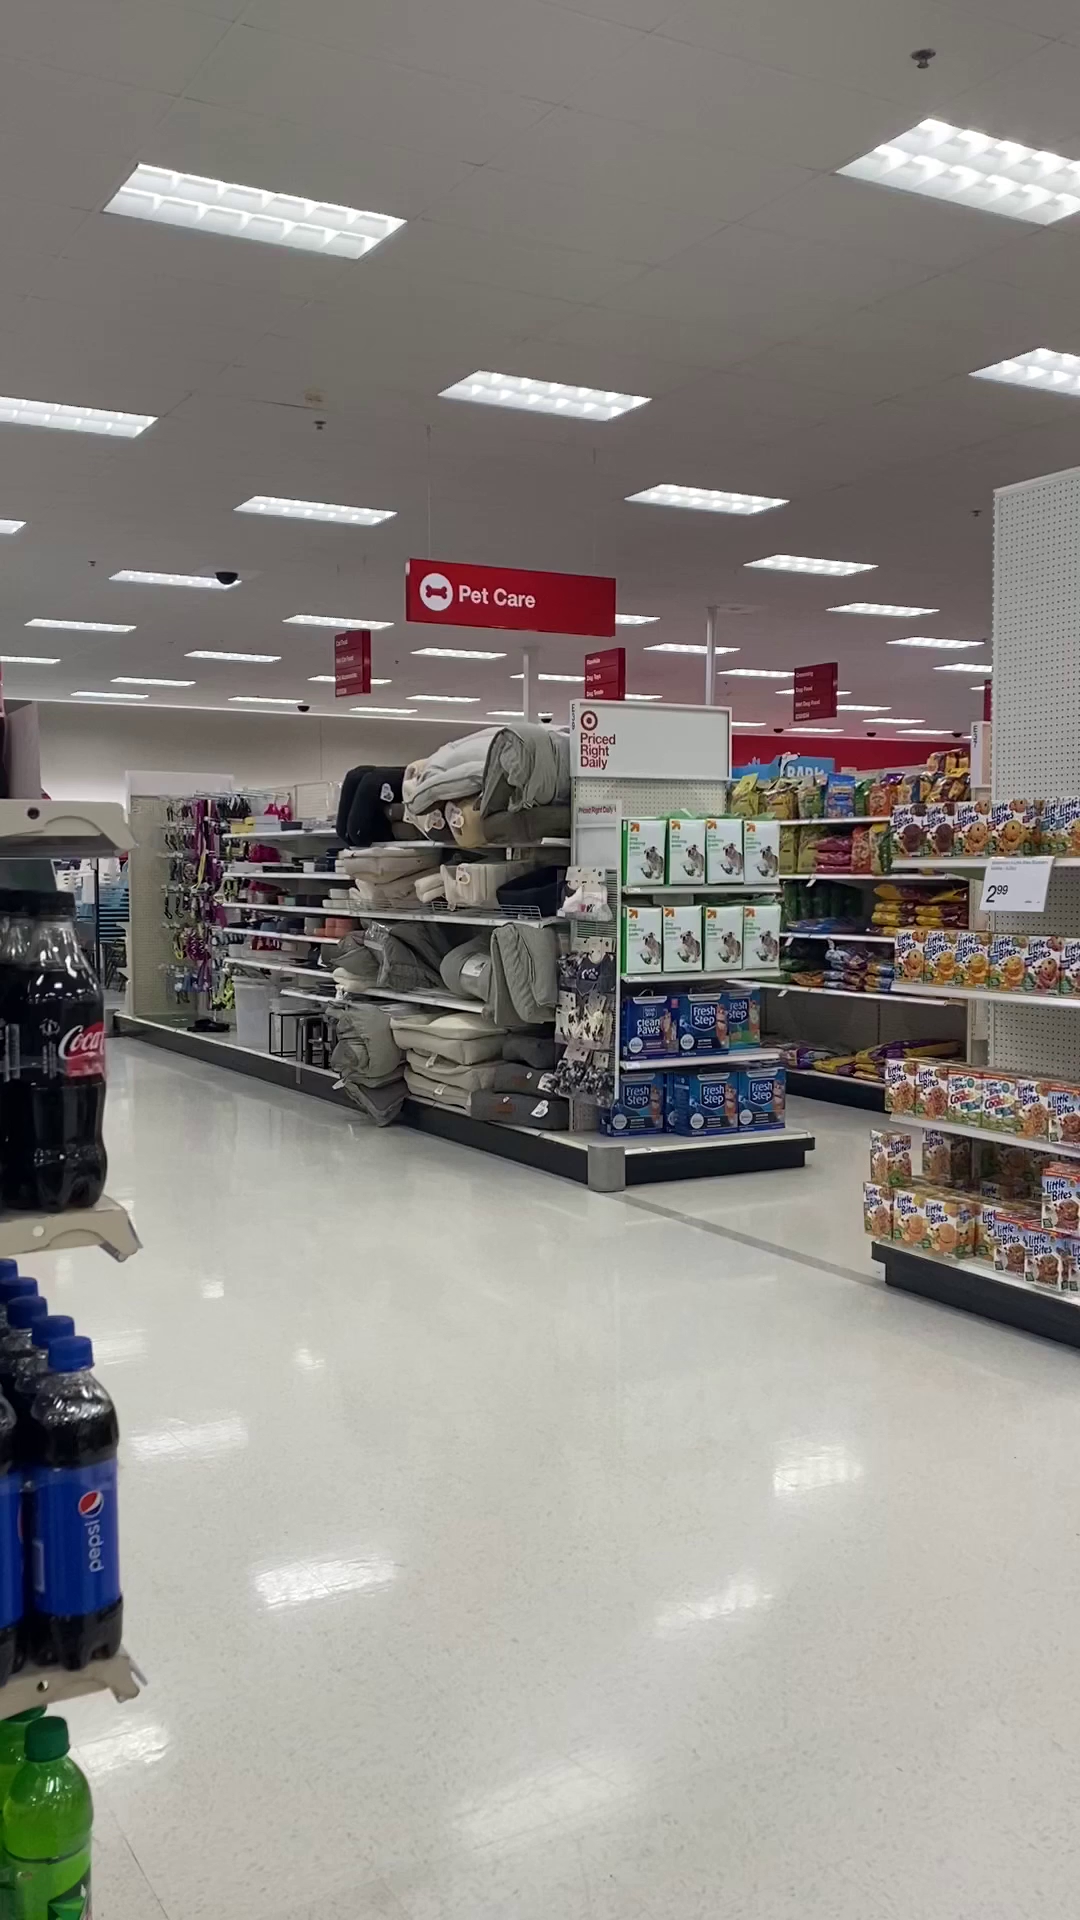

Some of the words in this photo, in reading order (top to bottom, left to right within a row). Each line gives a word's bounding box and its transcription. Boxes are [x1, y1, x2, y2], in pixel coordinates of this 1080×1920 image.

[459, 585, 488, 604] Pet
[494, 588, 536, 608] Care
[580, 733, 616, 745] Priced
[580, 744, 609, 758] Right
[580, 756, 608, 770] Daily
[958, 805, 973, 821] Little
[992, 803, 1008, 819] Little
[962, 815, 979, 827] Bites
[997, 812, 1014, 825] Bites
[1066, 811, 1080, 824] Bite
[897, 932, 911, 947] Little
[928, 934, 944, 949] Little
[958, 936, 976, 951] Little
[994, 938, 1011, 953] Little
[902, 942, 916, 952] Bites
[932, 943, 948, 955] Bites
[963, 946, 979, 957] Bites
[1028, 940, 1045, 955] Little
[999, 948, 1016, 960] Bites
[1033, 950, 1051, 962] Bites
[694, 1006, 716, 1016] Fresh
[730, 1000, 748, 1010] resh
[695, 1015, 715, 1026] Step
[888, 1064, 902, 1078] Little
[919, 1069, 933, 1083] Little
[892, 1074, 906, 1083] Bites
[924, 1079, 939, 1089] Bites
[626, 1086, 649, 1096] Fresh
[703, 1084, 724, 1095] Fresh
[752, 1082, 772, 1091] Fresh
[1018, 1084, 1034, 1098] Little
[627, 1095, 648, 1106] Step
[704, 1094, 724, 1104] Step
[752, 1091, 772, 1100] Step
[1022, 1094, 1040, 1106] Bites
[1052, 1094, 1069, 1108] Little
[1056, 1105, 1075, 1116] Bites
[1046, 1179, 1066, 1194] Little
[866, 1187, 878, 1200] Little
[1052, 1191, 1072, 1201] Bites
[870, 1198, 882, 1207] Bites
[897, 1196, 912, 1208] Little
[902, 1205, 917, 1215] Bites
[926, 1204, 942, 1217] Little
[931, 1214, 948, 1224] Bites
[998, 1224, 1014, 1237] Little
[1002, 1235, 1020, 1245] Bites
[1029, 1234, 1046, 1247] Little
[1034, 1245, 1052, 1256] Bites
[84, 1519, 104, 1572] pepsi
